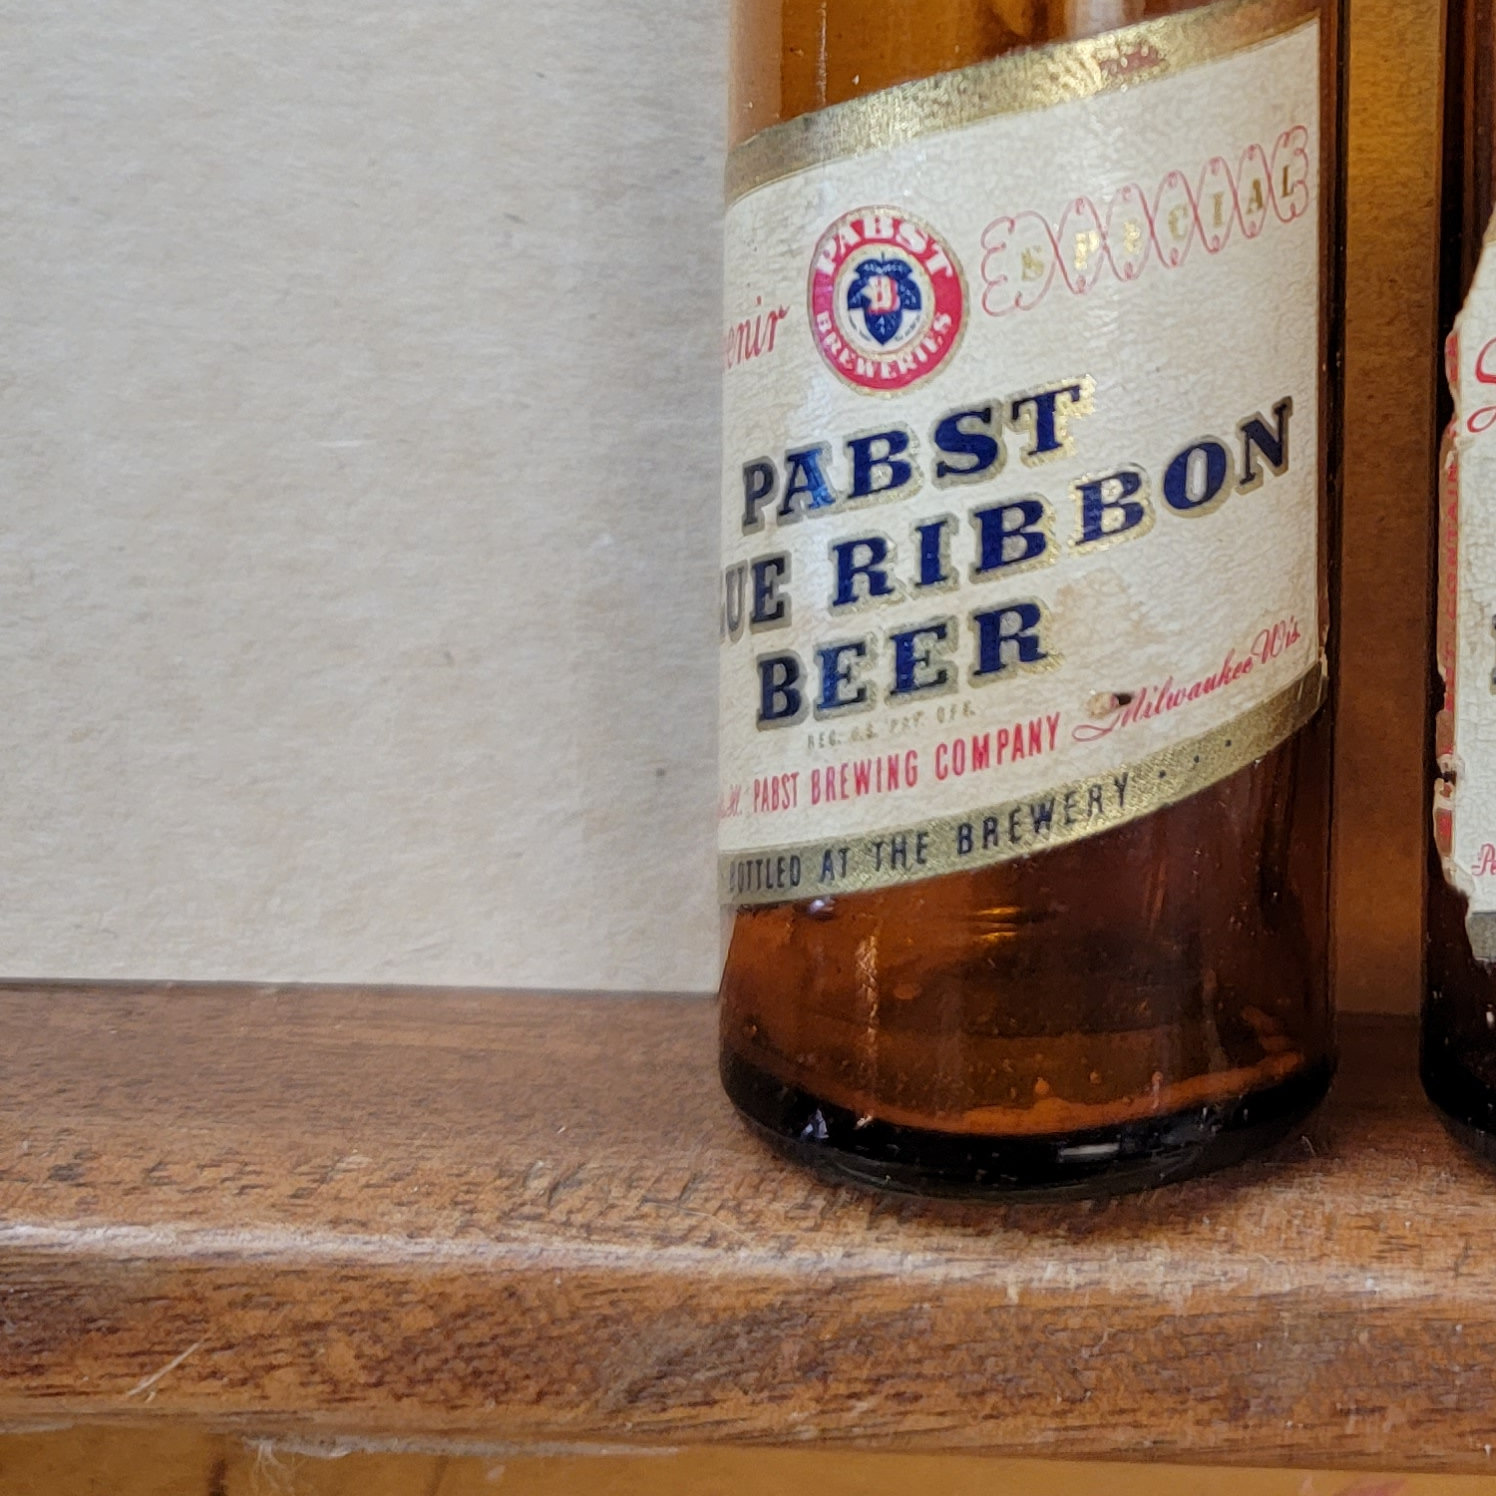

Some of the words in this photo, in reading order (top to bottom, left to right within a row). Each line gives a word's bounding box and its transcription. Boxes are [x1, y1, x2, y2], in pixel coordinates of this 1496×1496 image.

[816, 214, 953, 277] PABST
[1020, 164, 1297, 282] SPECIAL
[815, 311, 952, 380] BREWERIES
[743, 384, 1083, 525] PABST
[720, 554, 790, 639] UE
[830, 401, 1291, 608] RIBBON
[756, 602, 1050, 724] BEER
[754, 771, 800, 814] PABST
[811, 750, 919, 805] BREWING
[935, 712, 1061, 781] COMPANY
[1072, 647, 1254, 743] Milwaukee
[729, 854, 801, 894] BOTTLED
[819, 848, 850, 882] AT
[871, 831, 929, 873] THE
[956, 772, 1131, 858] BREWERY
